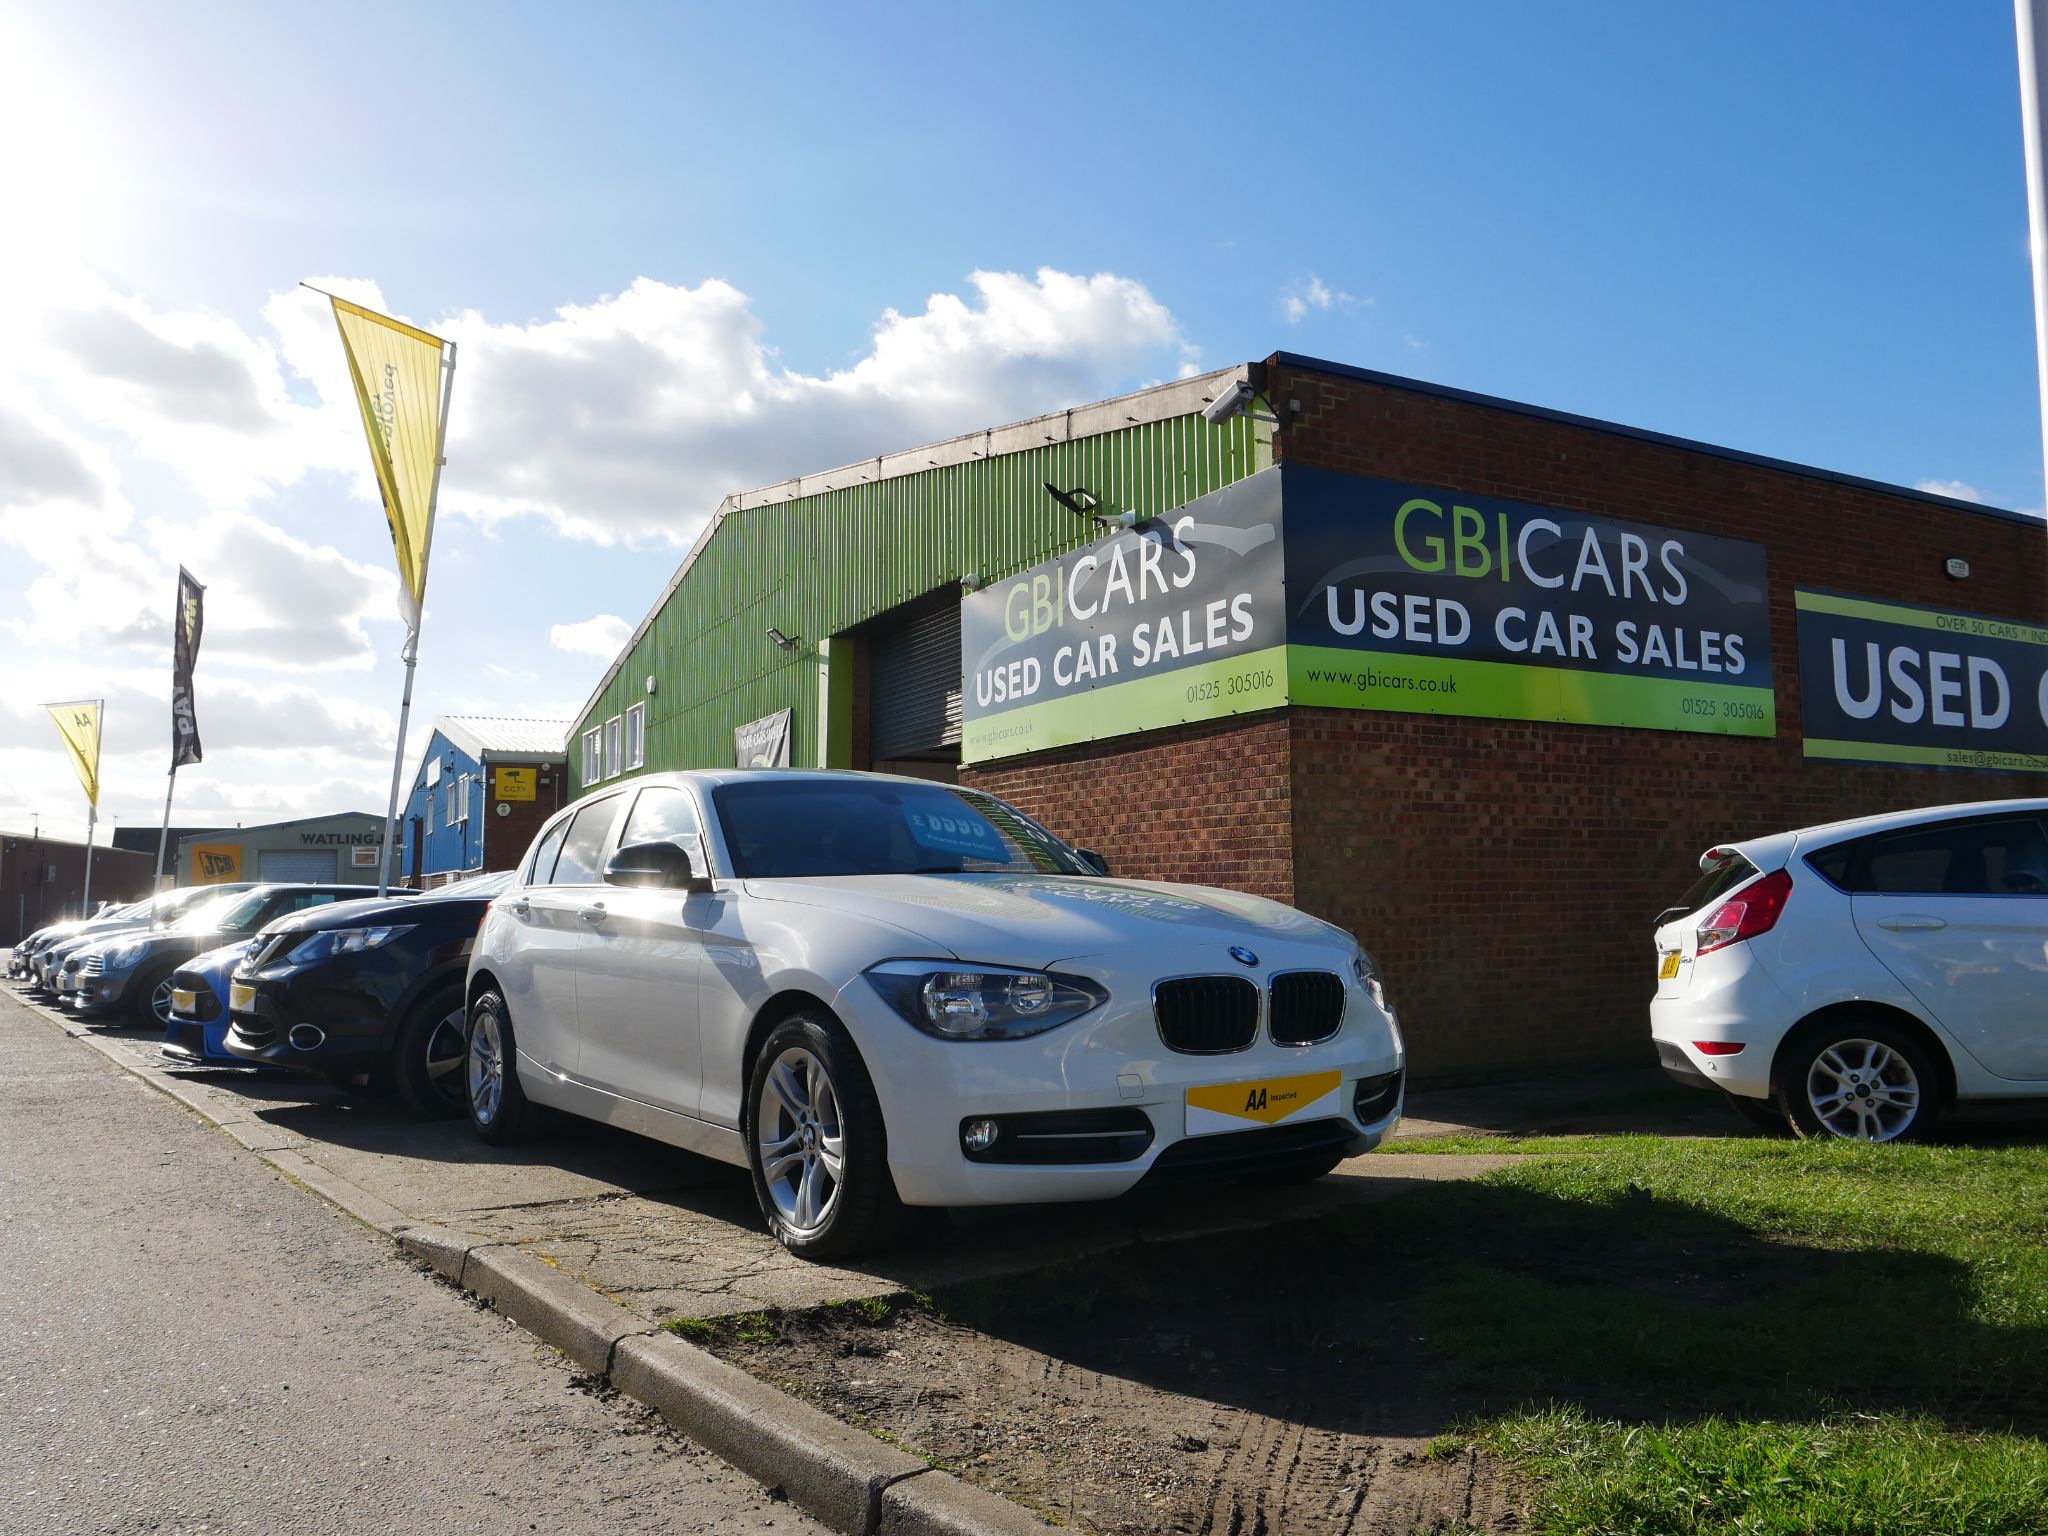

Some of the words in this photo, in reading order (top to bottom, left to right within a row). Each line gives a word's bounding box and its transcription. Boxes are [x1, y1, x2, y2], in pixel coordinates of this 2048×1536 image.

[1394, 498, 1688, 606] GBICARS
[1004, 515, 1196, 642] GBICARS
[1326, 585, 1471, 645] USED
[1495, 606, 1598, 660] CAR
[1616, 620, 1746, 675] SALES
[1936, 616, 1968, 632] OVER
[1971, 622, 1984, 634] 50
[1988, 623, 2018, 639] CARS
[976, 657, 1041, 707] USED
[1053, 633, 1119, 687] CAR
[1132, 593, 1254, 667] SALES
[1187, 680, 1220, 703] 01525
[1227, 669, 1274, 696] 305016
[1307, 664, 1457, 696] www.gbicars.co.uk
[1831, 637, 2011, 730] USED
[1682, 697, 1716, 717] 01525
[1723, 700, 1765, 721] 305016
[969, 720, 1034, 745] www.gbicars.co.uk
[301, 833, 373, 845] WATLING
[205, 854, 232, 876] JCB
[1244, 1088, 1267, 1112] AA
[1270, 1091, 1297, 1102] Inspected
